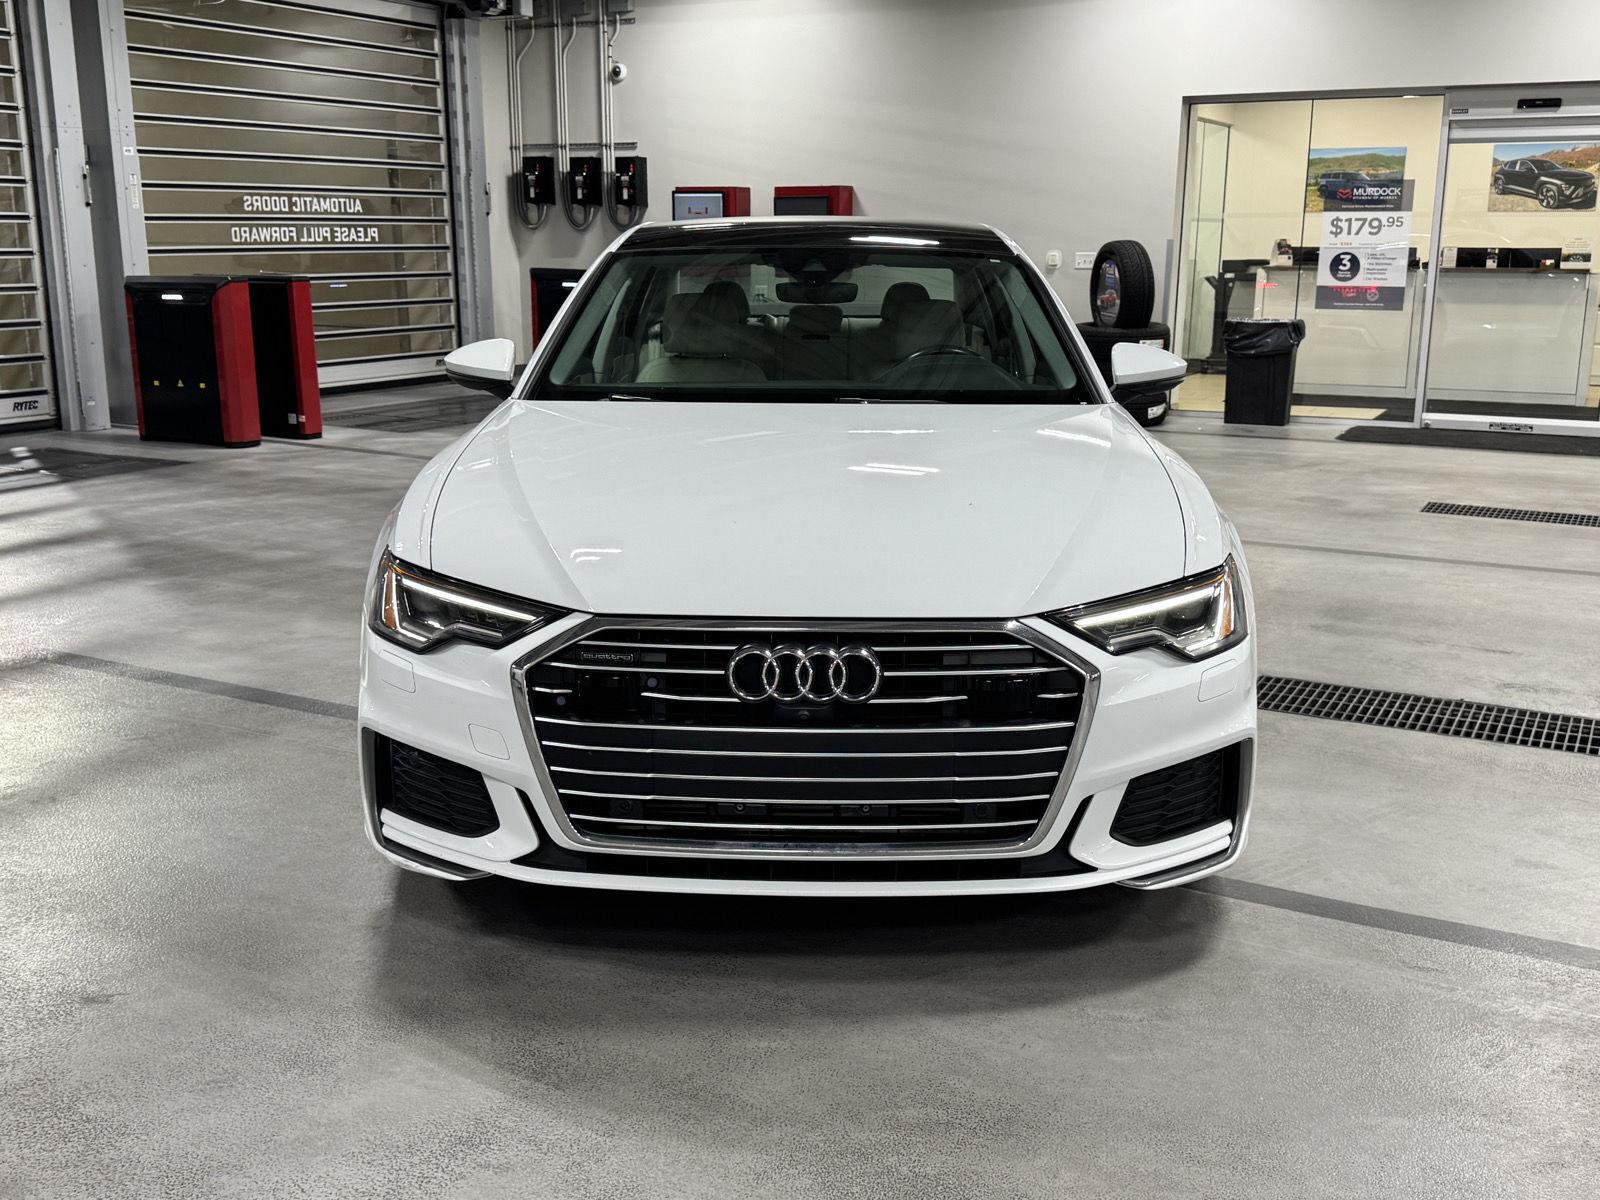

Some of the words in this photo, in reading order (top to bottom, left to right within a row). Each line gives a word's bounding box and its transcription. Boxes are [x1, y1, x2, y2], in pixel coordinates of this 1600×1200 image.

[1353, 187, 1401, 196] MURDOCK
[1329, 216, 1404, 238] $179.95
[1338, 254, 1351, 271] 3
[13, 400, 39, 411] RYTEC
